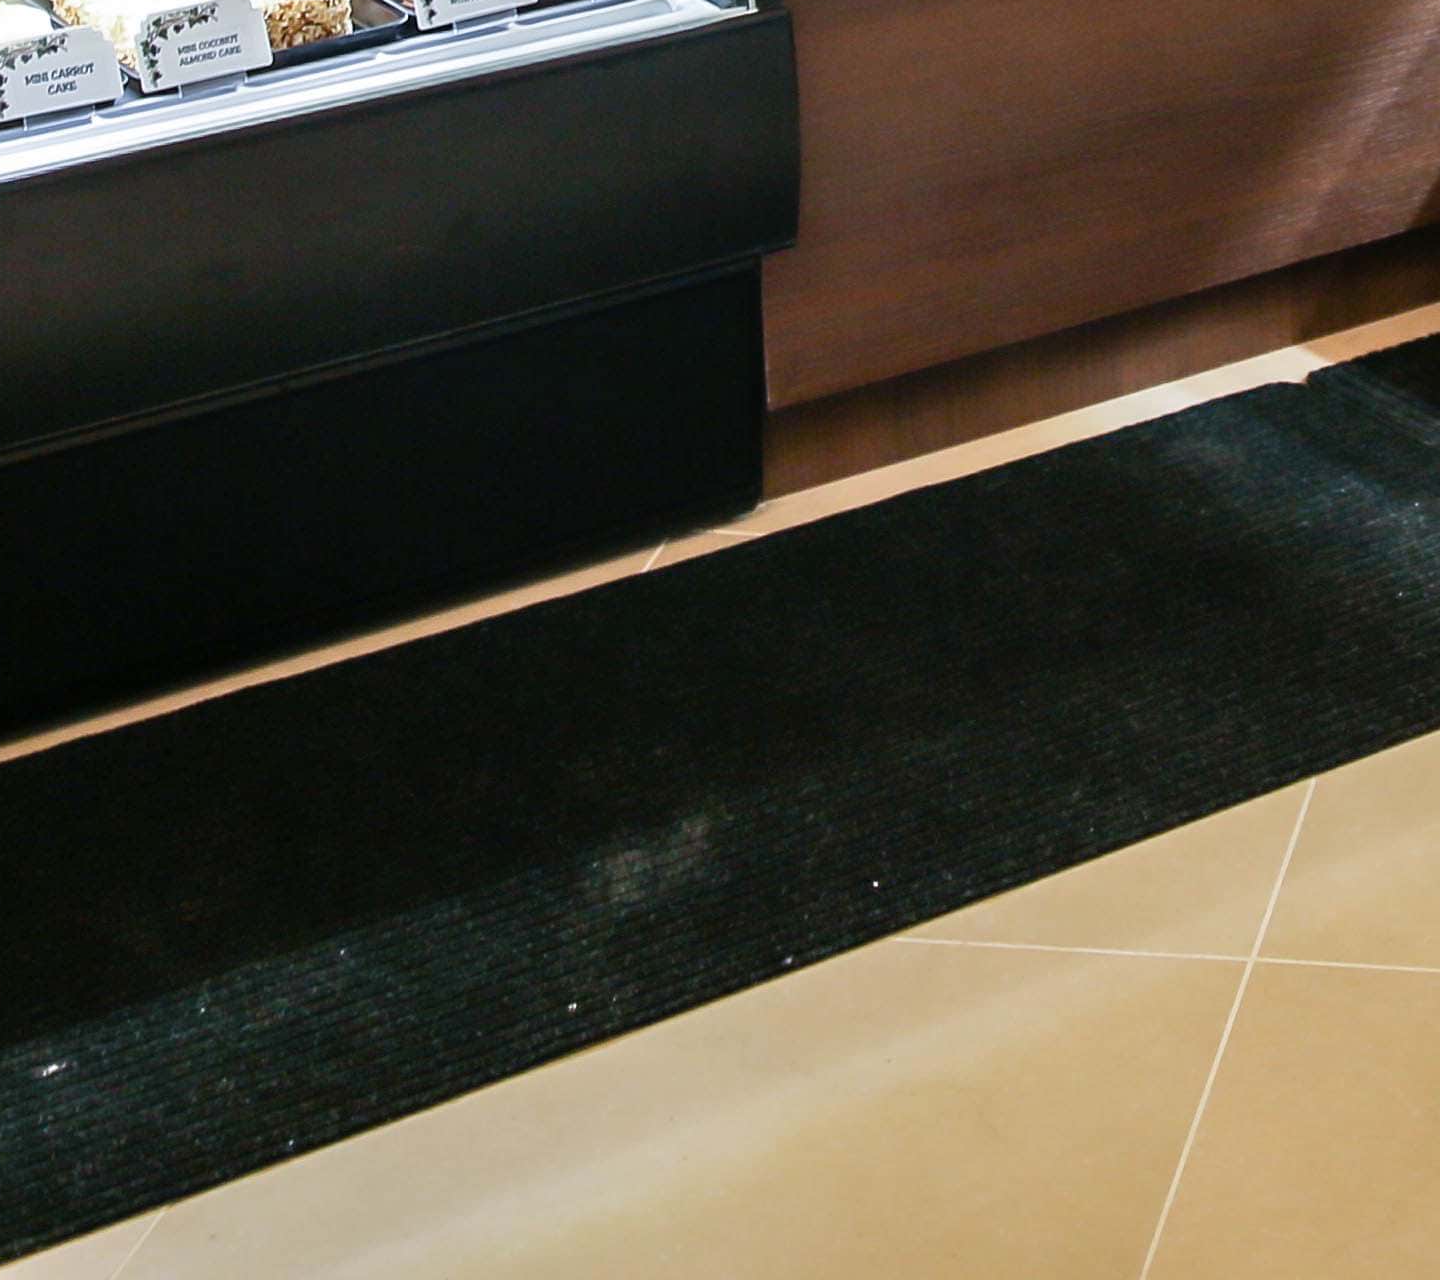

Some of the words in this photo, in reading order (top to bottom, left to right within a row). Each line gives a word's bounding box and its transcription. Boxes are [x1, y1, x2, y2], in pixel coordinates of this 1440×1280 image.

[179, 51, 217, 67] ALMOND
[219, 44, 243, 59] CAKE
[24, 71, 49, 86] MINI
[50, 62, 95, 81] CARROT
[47, 80, 78, 95] CAKE
